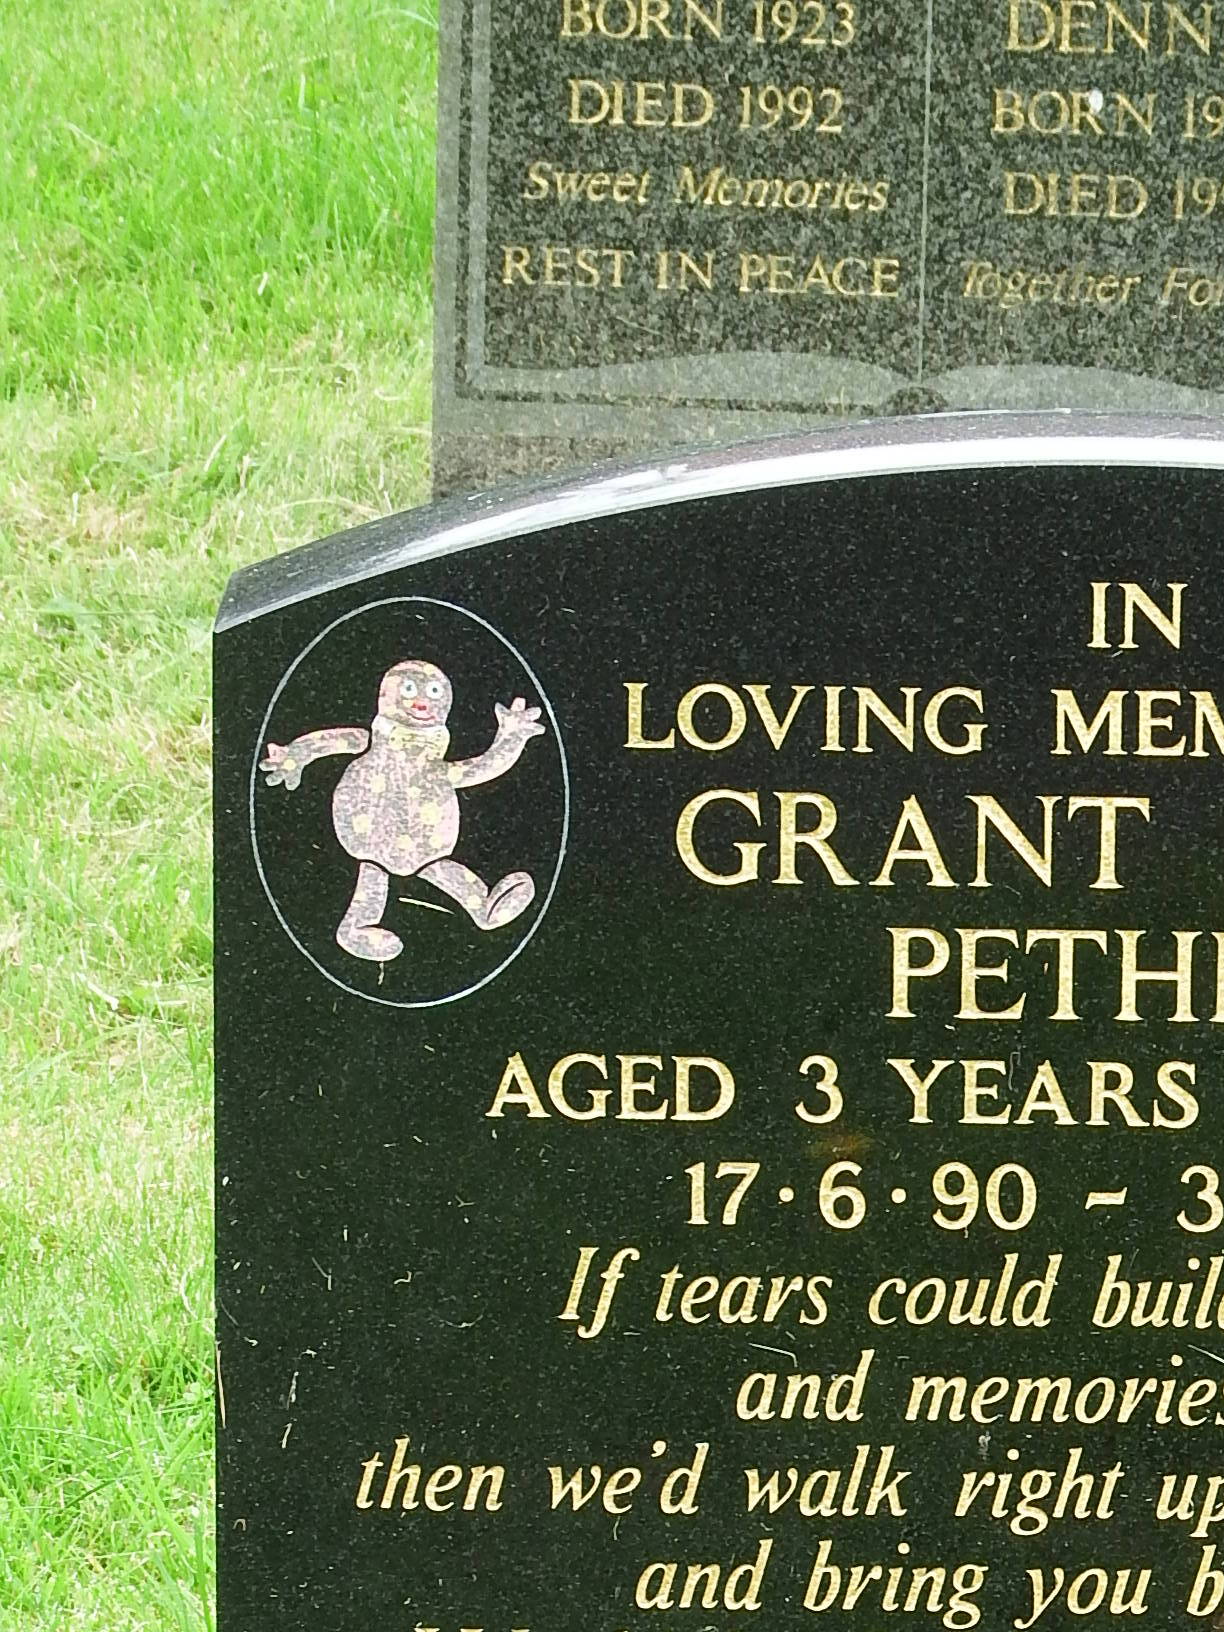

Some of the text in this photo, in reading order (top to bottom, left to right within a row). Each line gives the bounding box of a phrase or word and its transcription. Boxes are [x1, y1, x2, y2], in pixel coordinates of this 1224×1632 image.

[560, 0, 856, 46] BORN 1923
[567, 79, 845, 133] DIED 1992
[990, 89, 1158, 138] BORN
[522, 159, 892, 213] Sweet Memories
[1002, 171, 1149, 219] DIED
[499, 245, 901, 298] REST IN PEACE
[961, 260, 1142, 309] Together
[1087, 584, 1184, 651] IN
[623, 683, 988, 756] LOVING
[674, 789, 1155, 890] GRANT
[484, 1051, 737, 1122] AGED
[795, 1054, 844, 1124] 3
[886, 1058, 1201, 1129] YEARS
[557, 1246, 642, 1334] If
[655, 1265, 833, 1327] tears
[868, 1252, 1063, 1329] could
[736, 1347, 876, 1422] and
[356, 1439, 505, 1512] then
[548, 1440, 710, 1515] we'd
[743, 1444, 912, 1520] walk
[954, 1447, 1125, 1536] right
[632, 1539, 774, 1614] and
[803, 1539, 989, 1630] bring
[1013, 1567, 1152, 1630] you
